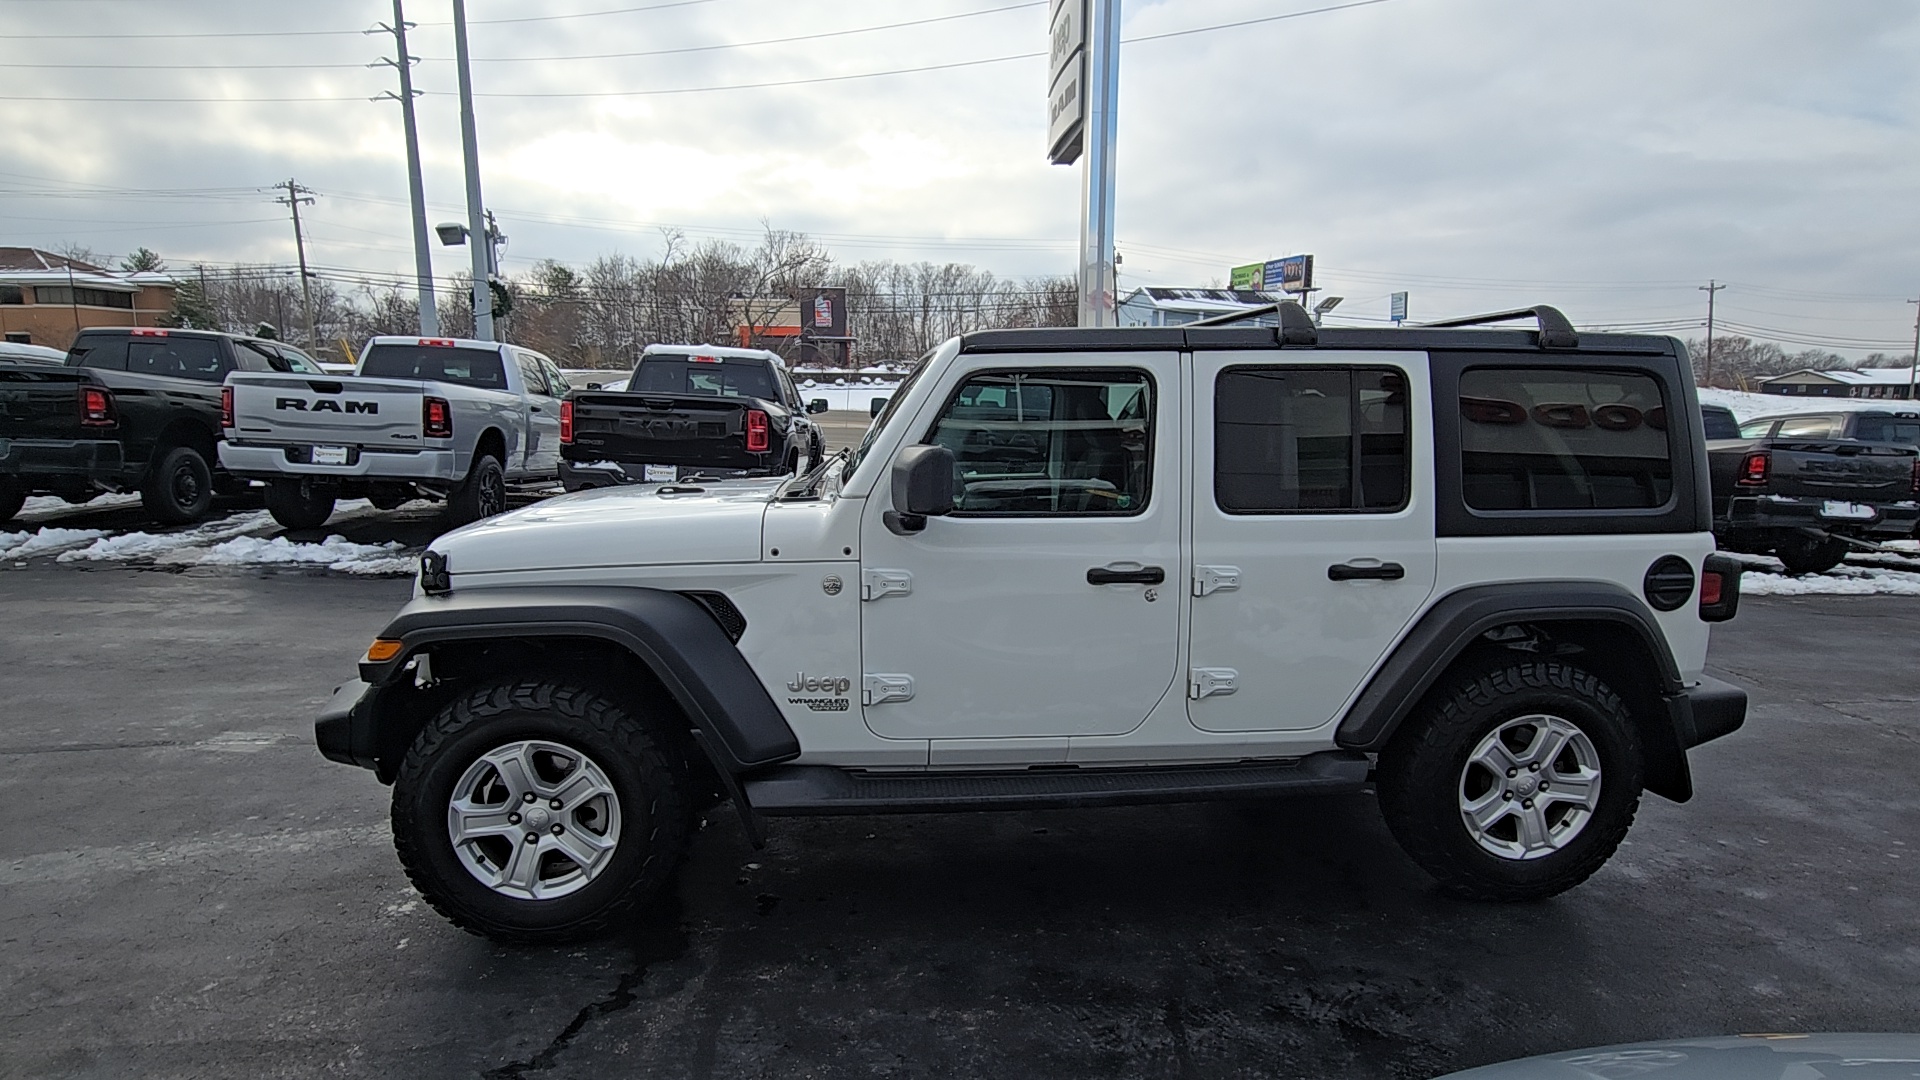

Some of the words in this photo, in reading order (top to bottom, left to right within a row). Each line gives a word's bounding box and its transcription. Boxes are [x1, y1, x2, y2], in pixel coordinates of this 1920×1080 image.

[1050, 13, 1071, 70] Jeep
[1051, 78, 1077, 127] RAM
[275, 397, 379, 415] RAM
[786, 671, 851, 696] Jeep
[787, 697, 850, 705] WRANGLER
